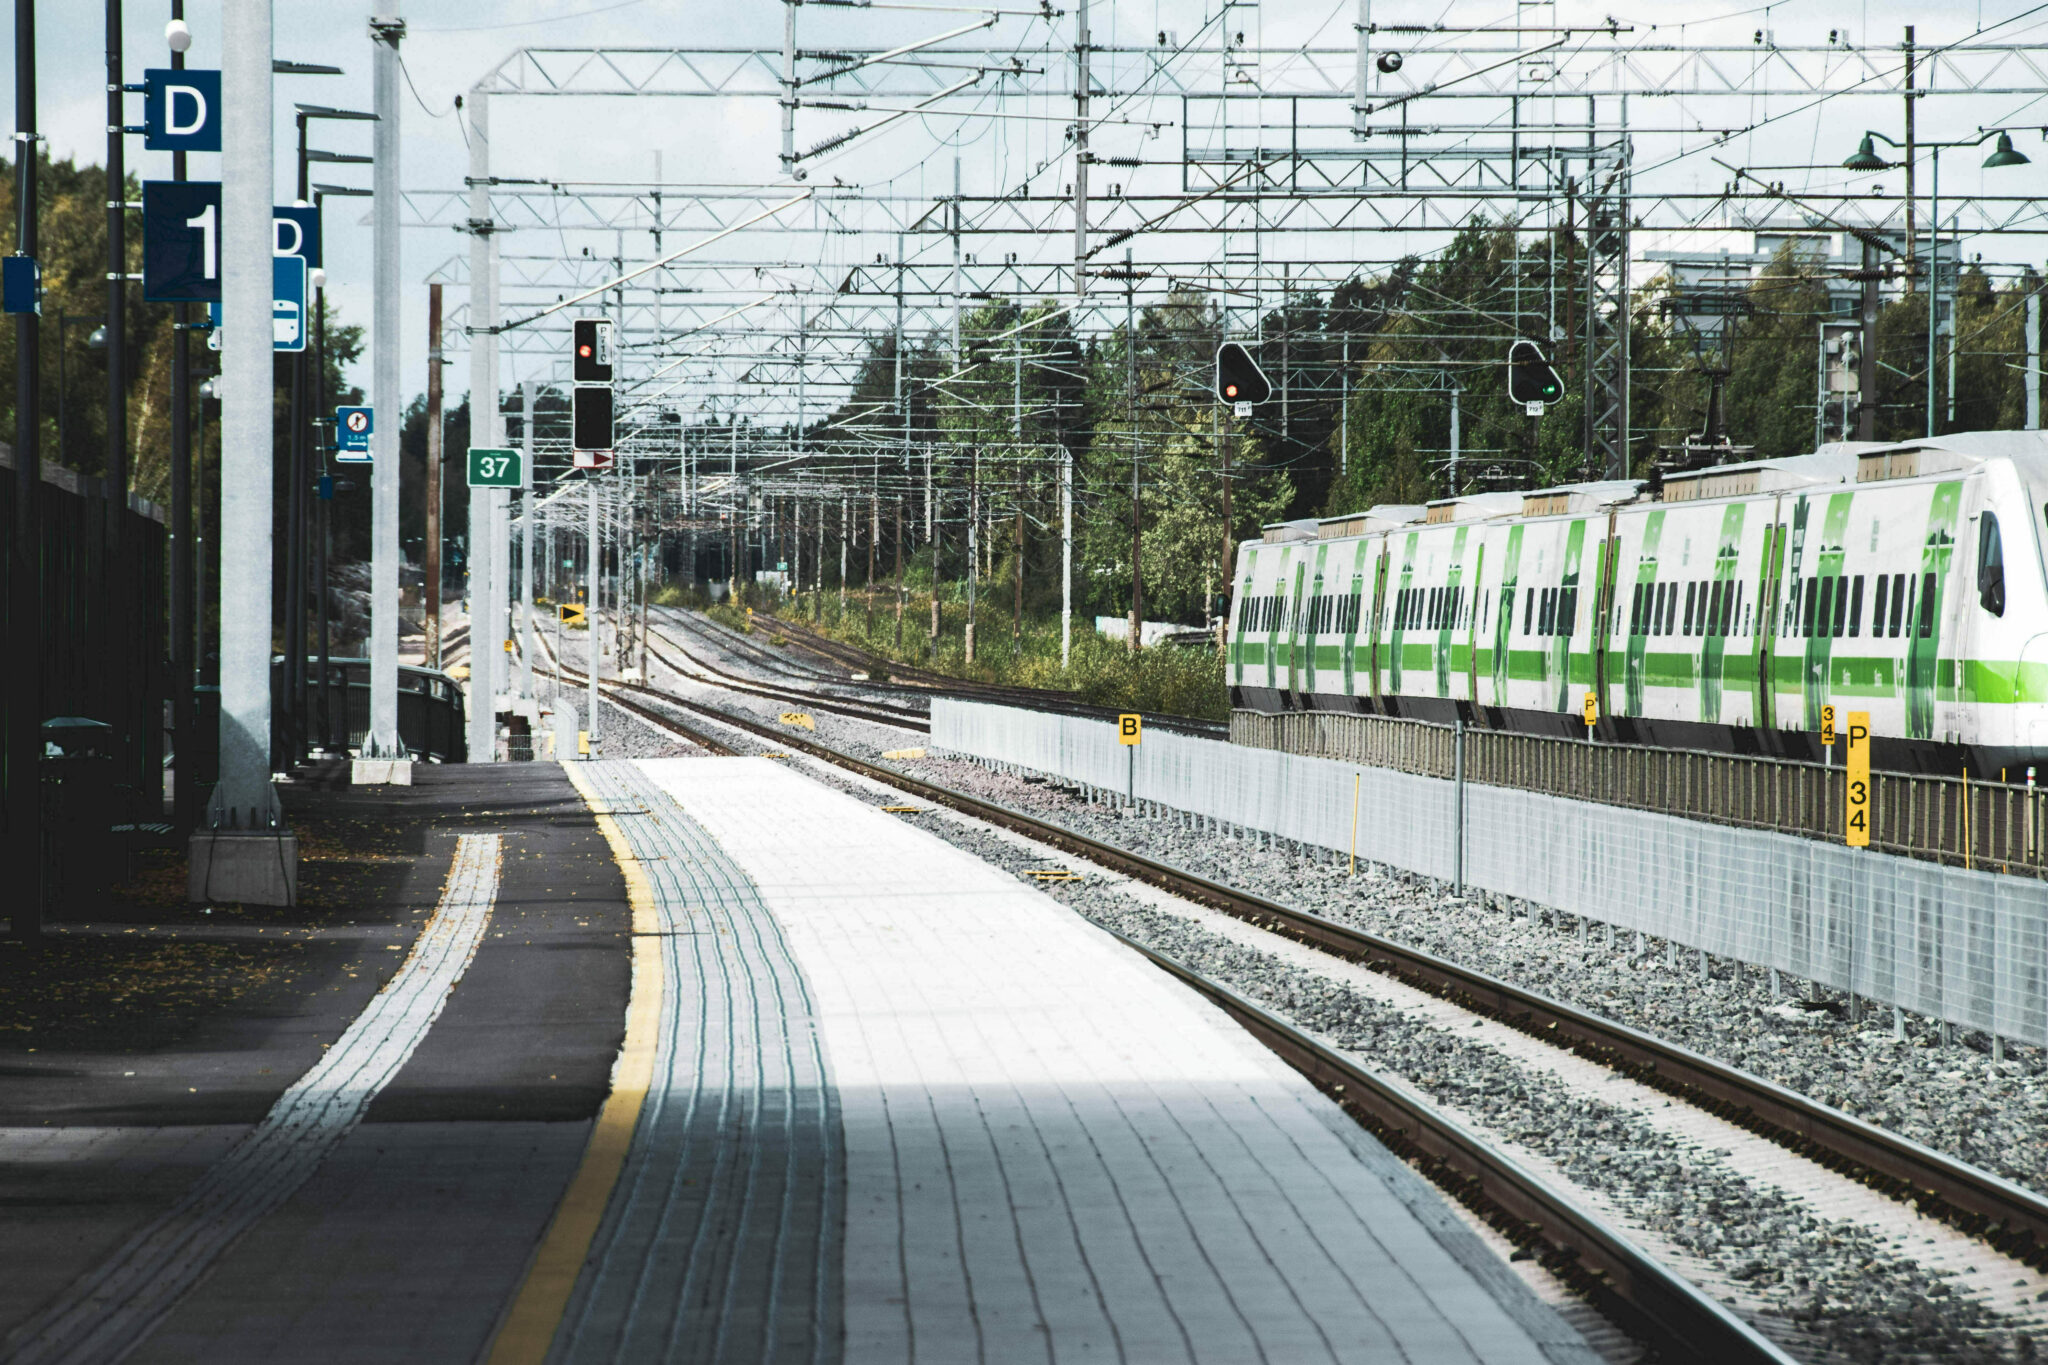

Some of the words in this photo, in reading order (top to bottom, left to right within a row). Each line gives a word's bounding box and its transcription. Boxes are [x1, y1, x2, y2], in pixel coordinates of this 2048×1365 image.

[165, 85, 207, 135] D
[186, 204, 216, 280] 1
[273, 218, 303, 255] D
[480, 456, 510, 478] 37
[1585, 699, 1594, 710] P
[1122, 717, 1137, 736] B
